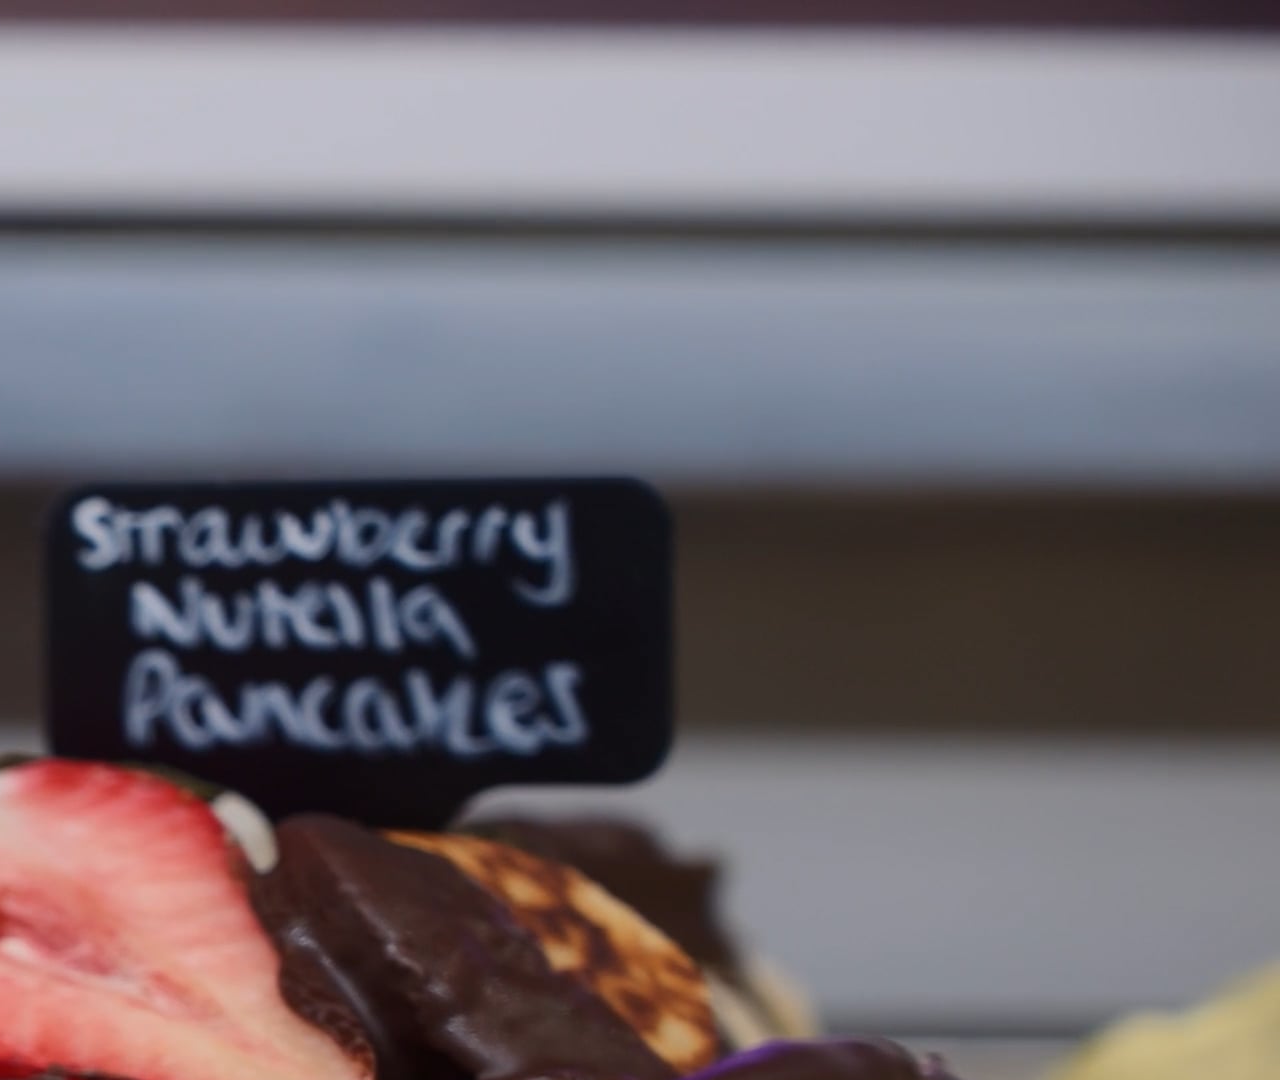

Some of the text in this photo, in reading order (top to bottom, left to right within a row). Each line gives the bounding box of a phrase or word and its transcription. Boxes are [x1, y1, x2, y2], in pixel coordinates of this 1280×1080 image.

[71, 497, 577, 606] Strawberry
[130, 575, 476, 658] Nutella
[124, 648, 589, 754] Pancakes
